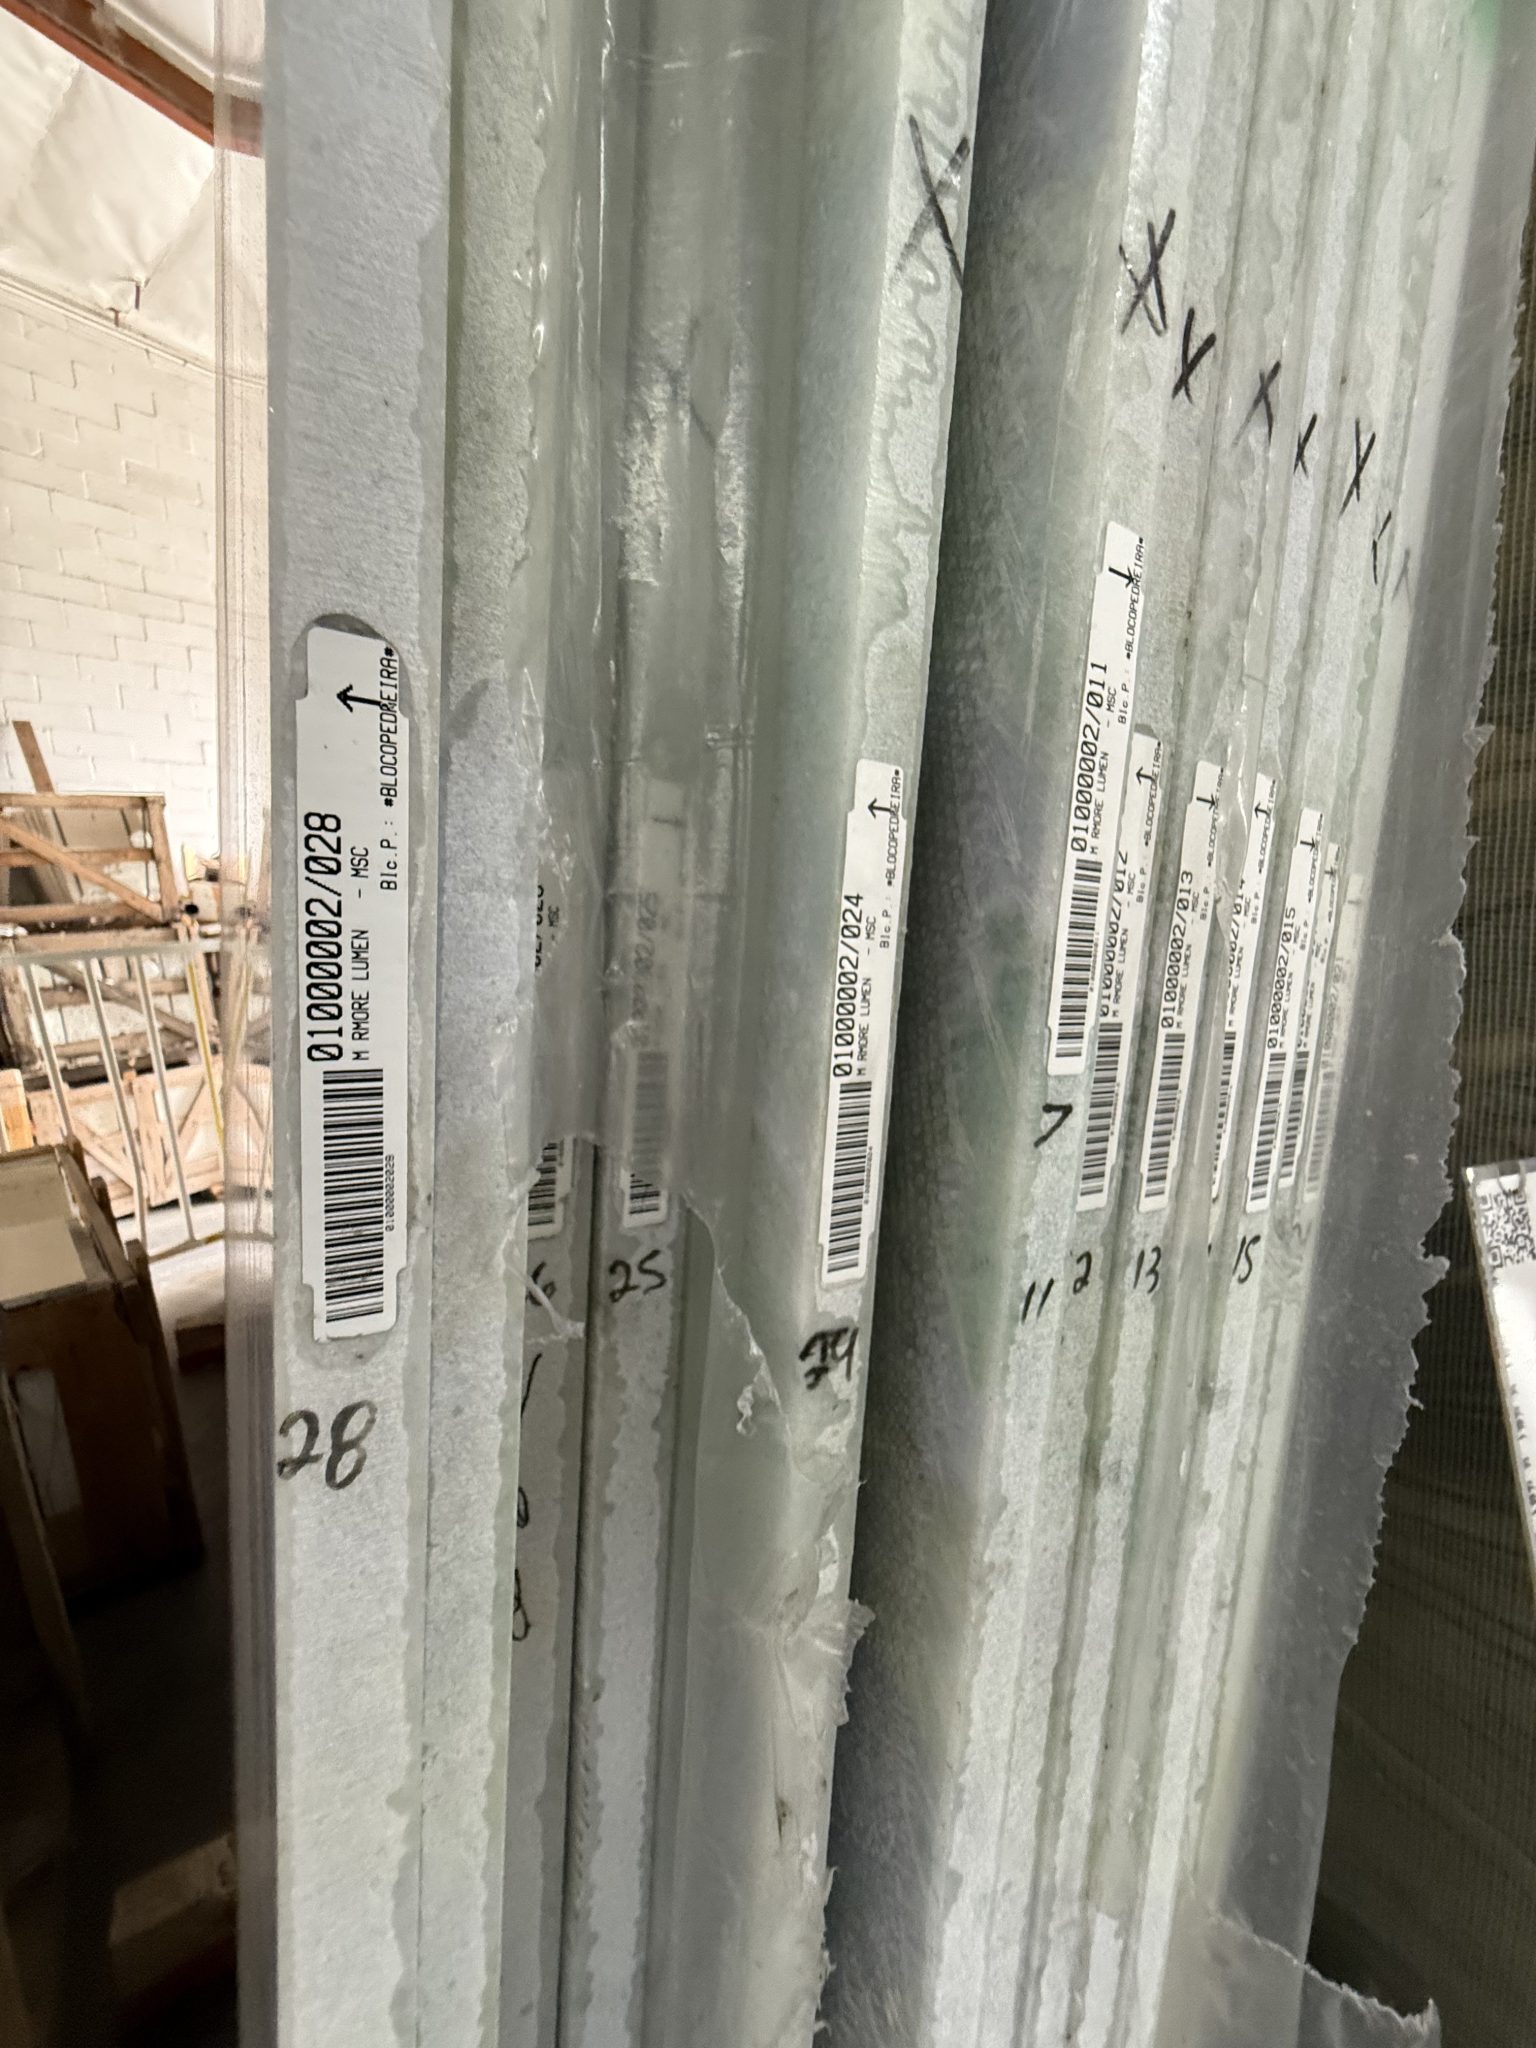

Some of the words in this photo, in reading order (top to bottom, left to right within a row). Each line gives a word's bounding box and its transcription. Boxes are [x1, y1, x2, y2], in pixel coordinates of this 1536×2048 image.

[1071, 662, 1107, 852] 01000002/011
[1092, 801, 1104, 840] RMORE
[1099, 752, 1109, 792] LUMEN
[1106, 687, 1117, 715] MSC
[350, 846, 369, 878] MSC
[304, 811, 343, 1061] 01000002/028
[865, 916, 877, 941] MSC
[1161, 870, 1193, 1029] 01000002/013
[352, 929, 369, 981] LUMEN
[1267, 907, 1296, 1049] 01000002/015
[833, 893, 863, 1078] 01000002/024
[860, 977, 871, 1017] LUMEN
[352, 991, 369, 1041] RMORE
[858, 1024, 869, 1060] RMORE
[608, 1249, 665, 1302] 25
[1133, 1246, 1161, 1294] 13
[1232, 1235, 1261, 1284] 15
[277, 1399, 378, 1490] 28
